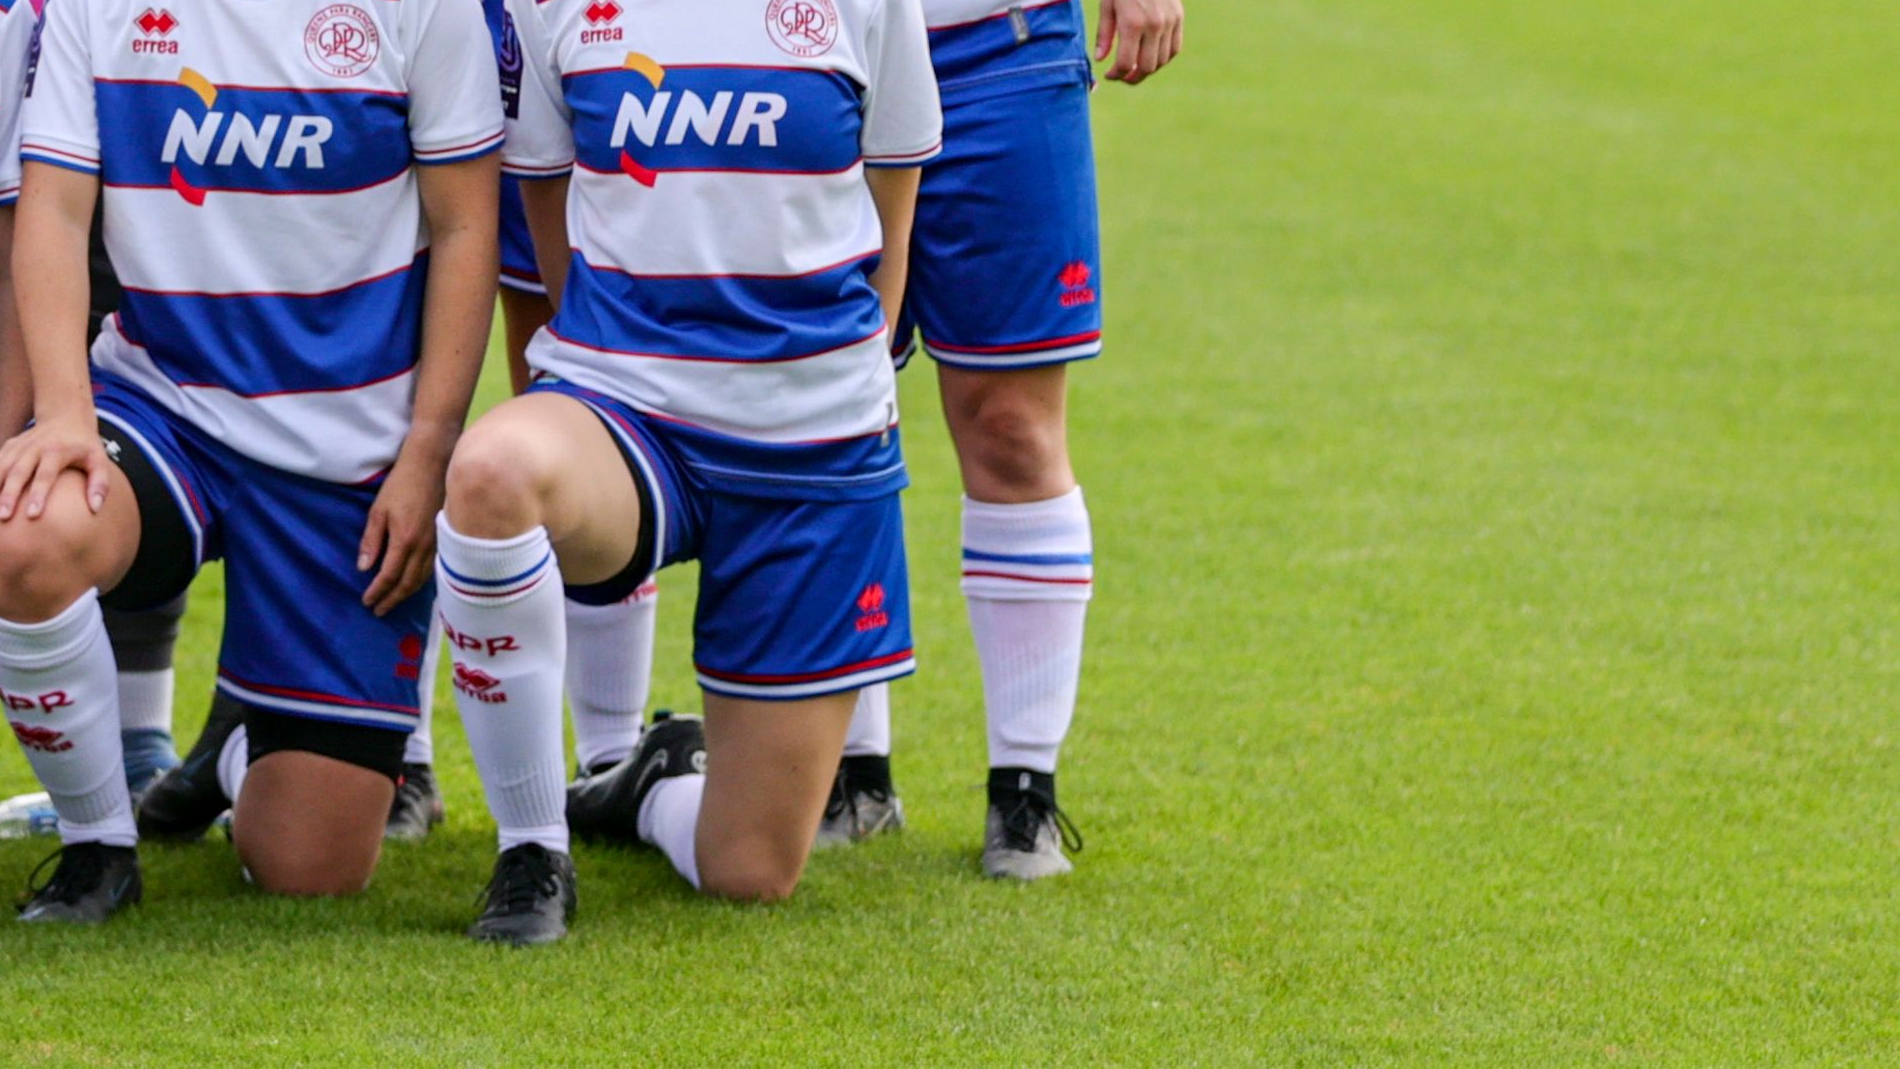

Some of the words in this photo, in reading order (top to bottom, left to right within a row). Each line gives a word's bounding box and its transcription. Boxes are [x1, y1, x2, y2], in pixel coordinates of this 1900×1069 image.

[133, 38, 179, 54] errea
[581, 25, 623, 44] errea
[610, 90, 787, 148] NNR
[161, 109, 333, 169] NNR
